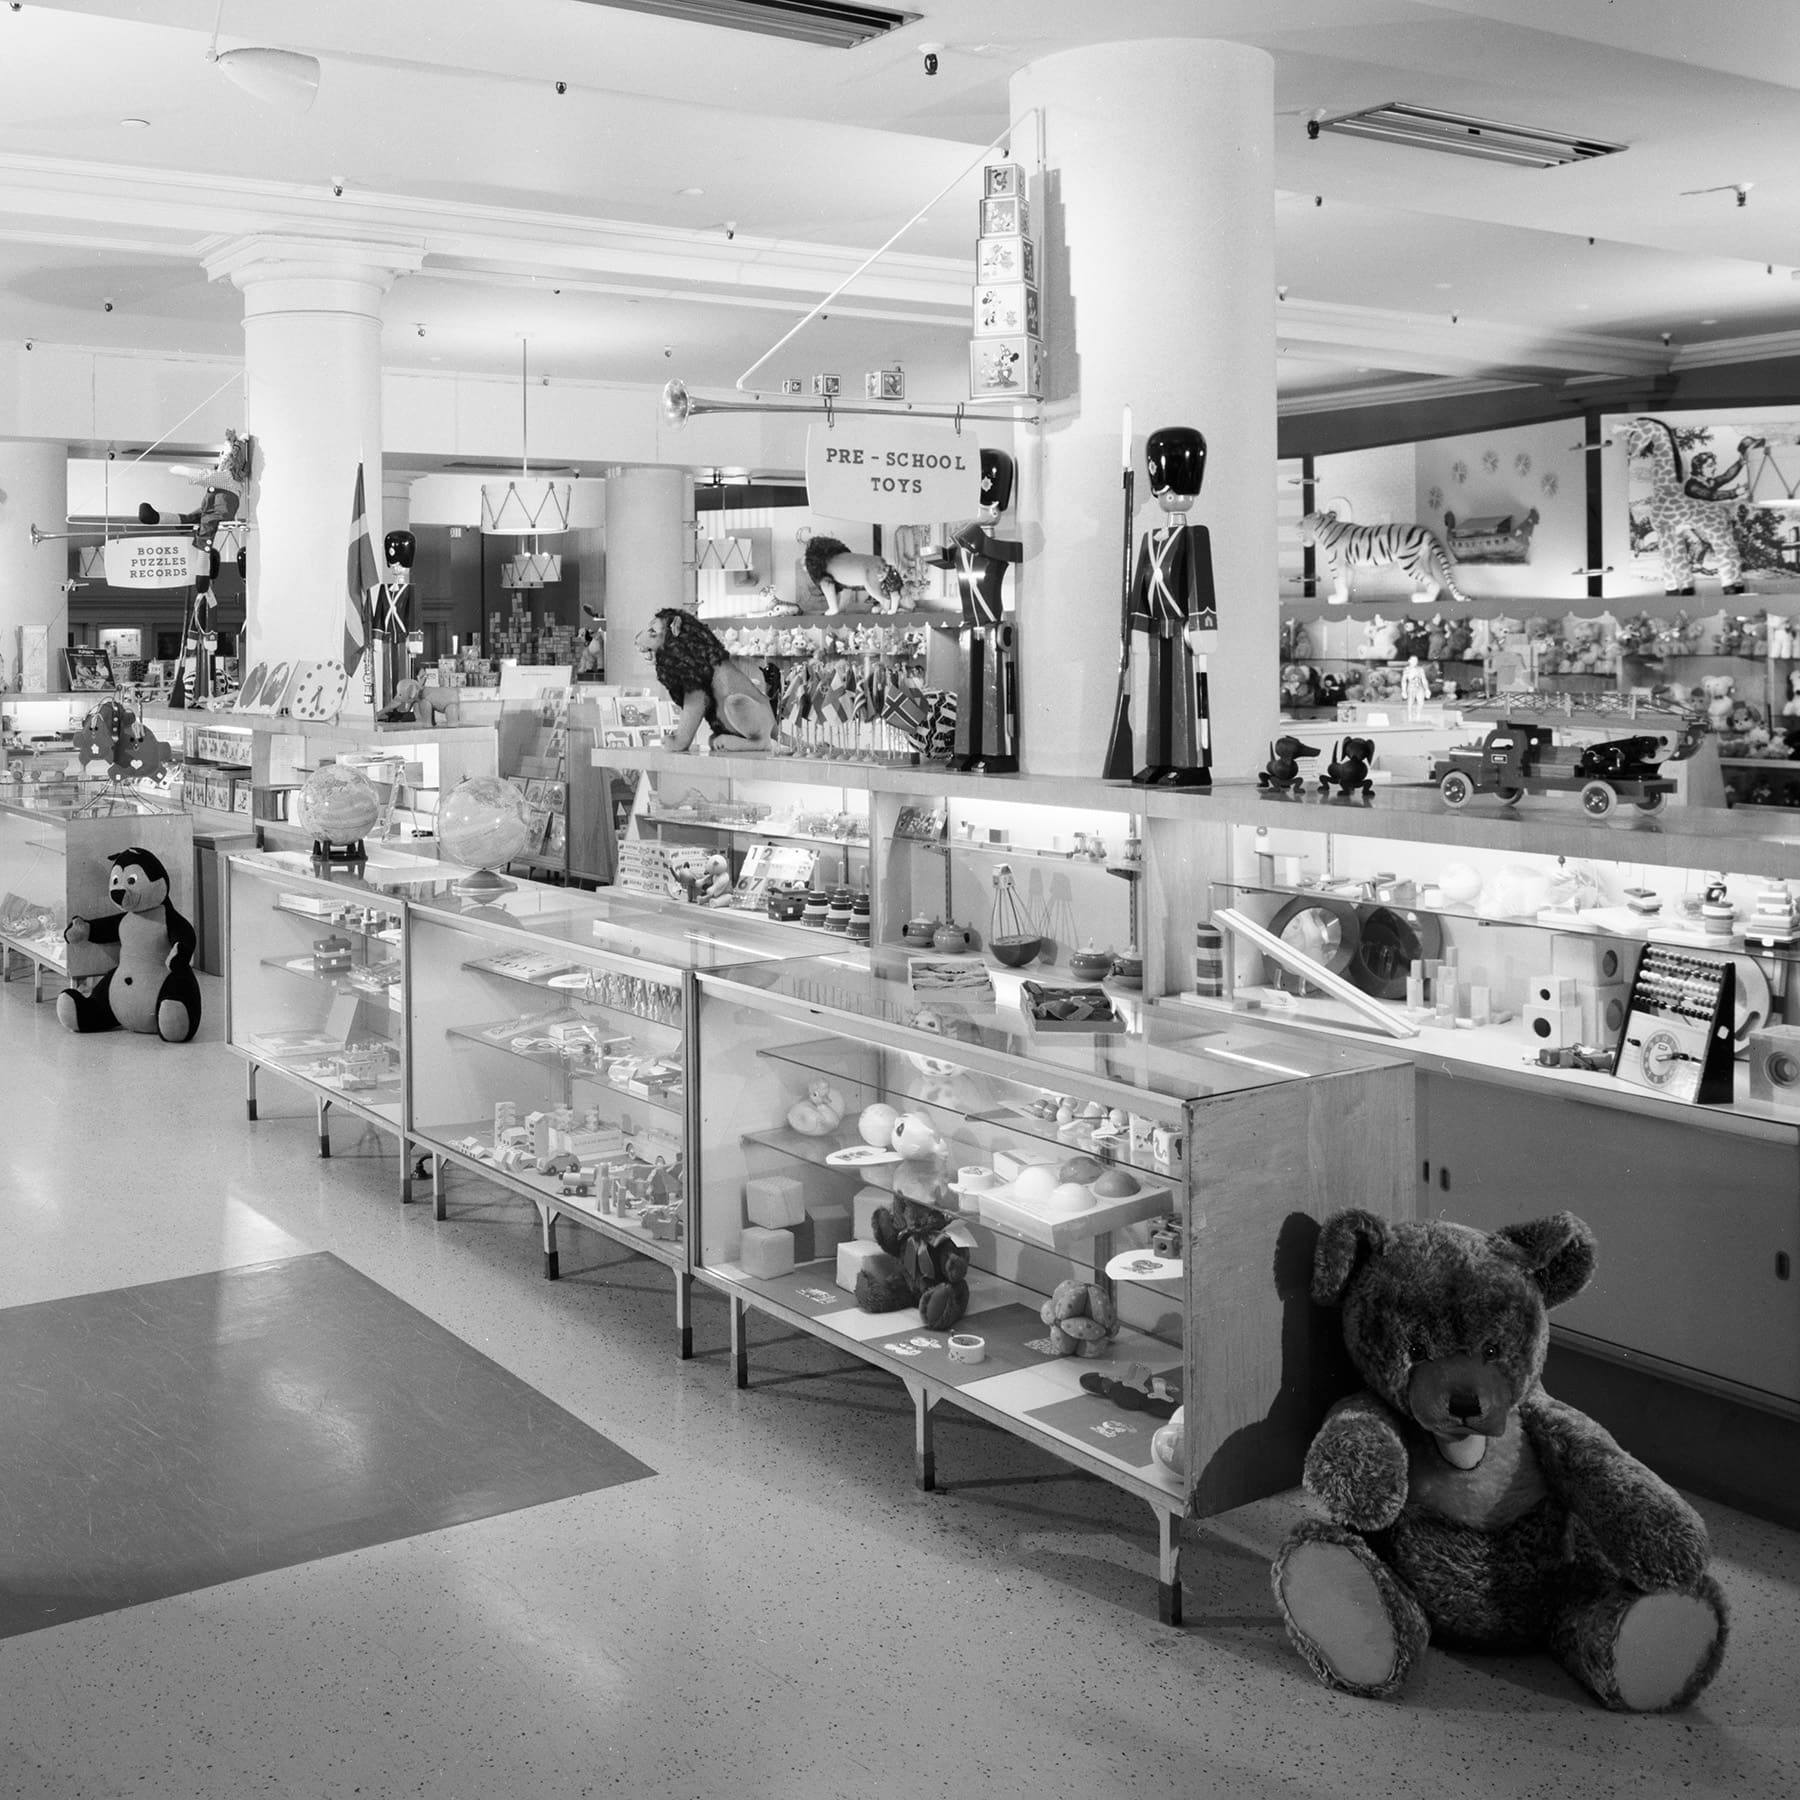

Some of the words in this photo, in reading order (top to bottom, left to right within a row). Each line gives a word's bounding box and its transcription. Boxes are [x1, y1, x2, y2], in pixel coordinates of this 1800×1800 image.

[826, 448, 864, 464] PRE
[886, 452, 966, 470] SCHOOL
[871, 477, 922, 493] TOYS
[137, 546, 179, 556] BOOKS
[131, 557, 187, 567] PUZZLES
[130, 568, 188, 578] RECORDS
[751, 847, 758, 860] 1
[763, 847, 773, 860] 2
[738, 876, 749, 890] 6
[750, 877, 763, 891] 7
